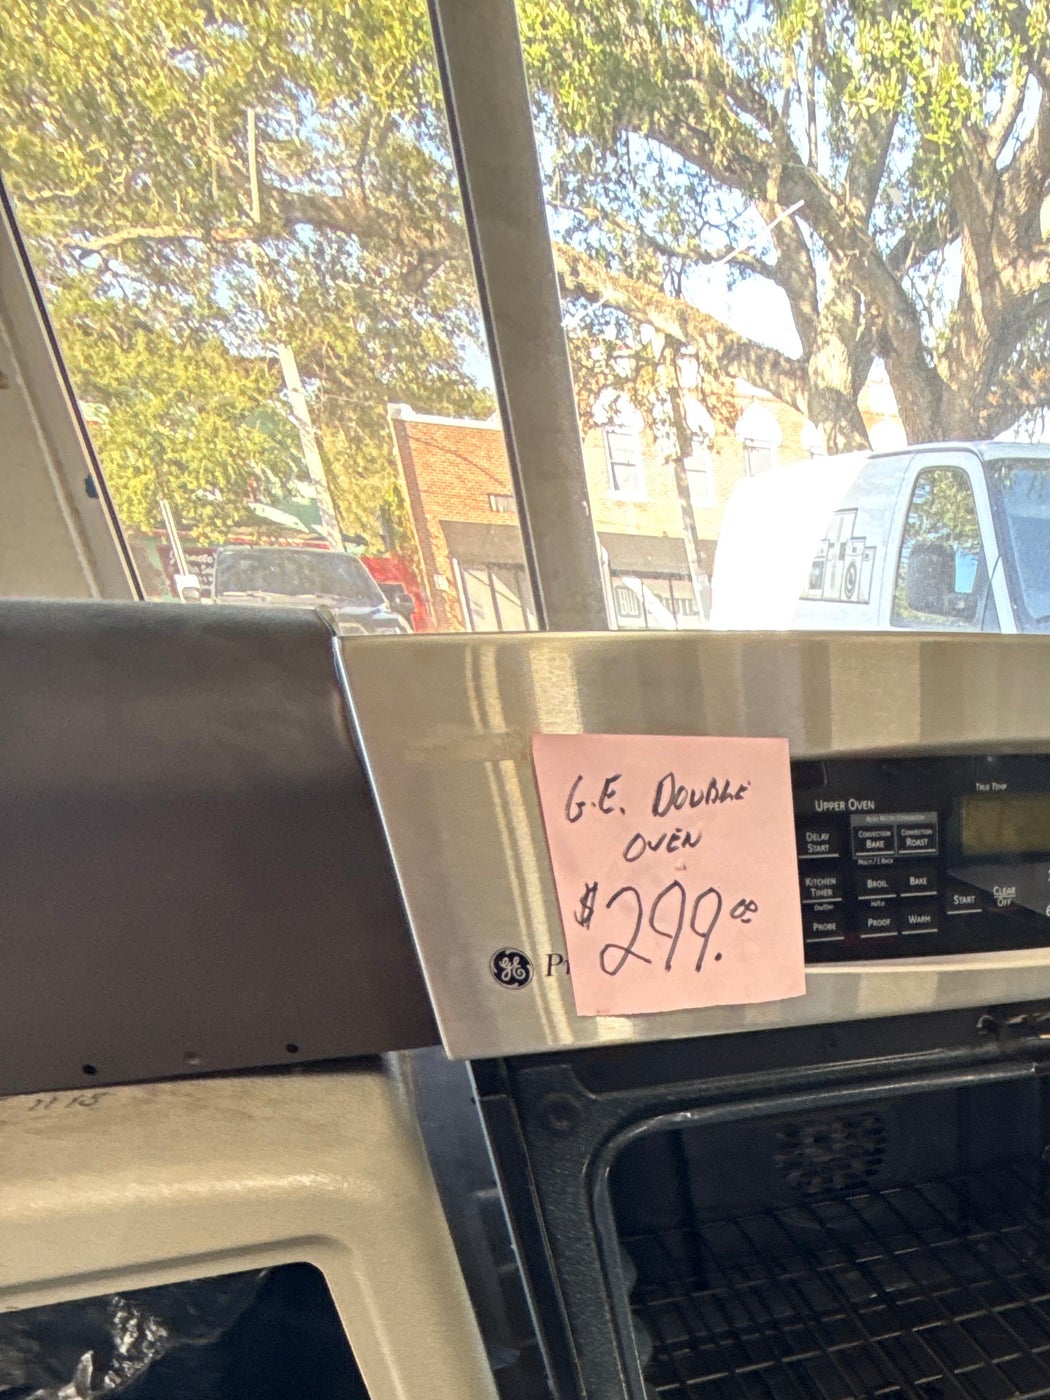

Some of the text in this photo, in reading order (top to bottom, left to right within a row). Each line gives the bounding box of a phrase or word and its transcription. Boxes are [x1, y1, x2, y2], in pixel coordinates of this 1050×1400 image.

[651, 771, 751, 818] DOUBLE
[815, 798, 875, 812] UPPER OVEN
[806, 831, 830, 843] DELAY
[858, 829, 891, 839] CONVECTION
[622, 828, 704, 863] OVEN
[866, 839, 885, 849] BAKE
[906, 837, 928, 847] ROAST
[808, 842, 830, 853] START
[805, 877, 836, 887] KITCHEN
[867, 879, 888, 889] BROIL
[909, 876, 928, 886] BAKE
[810, 887, 833, 898] TIMER
[993, 885, 1016, 896] CLEAR
[953, 894, 976, 905] START
[997, 897, 1012, 907] OFF
[867, 918, 891, 929] PROOF
[907, 914, 931, 924] WARM
[813, 922, 836, 932] PROBE
